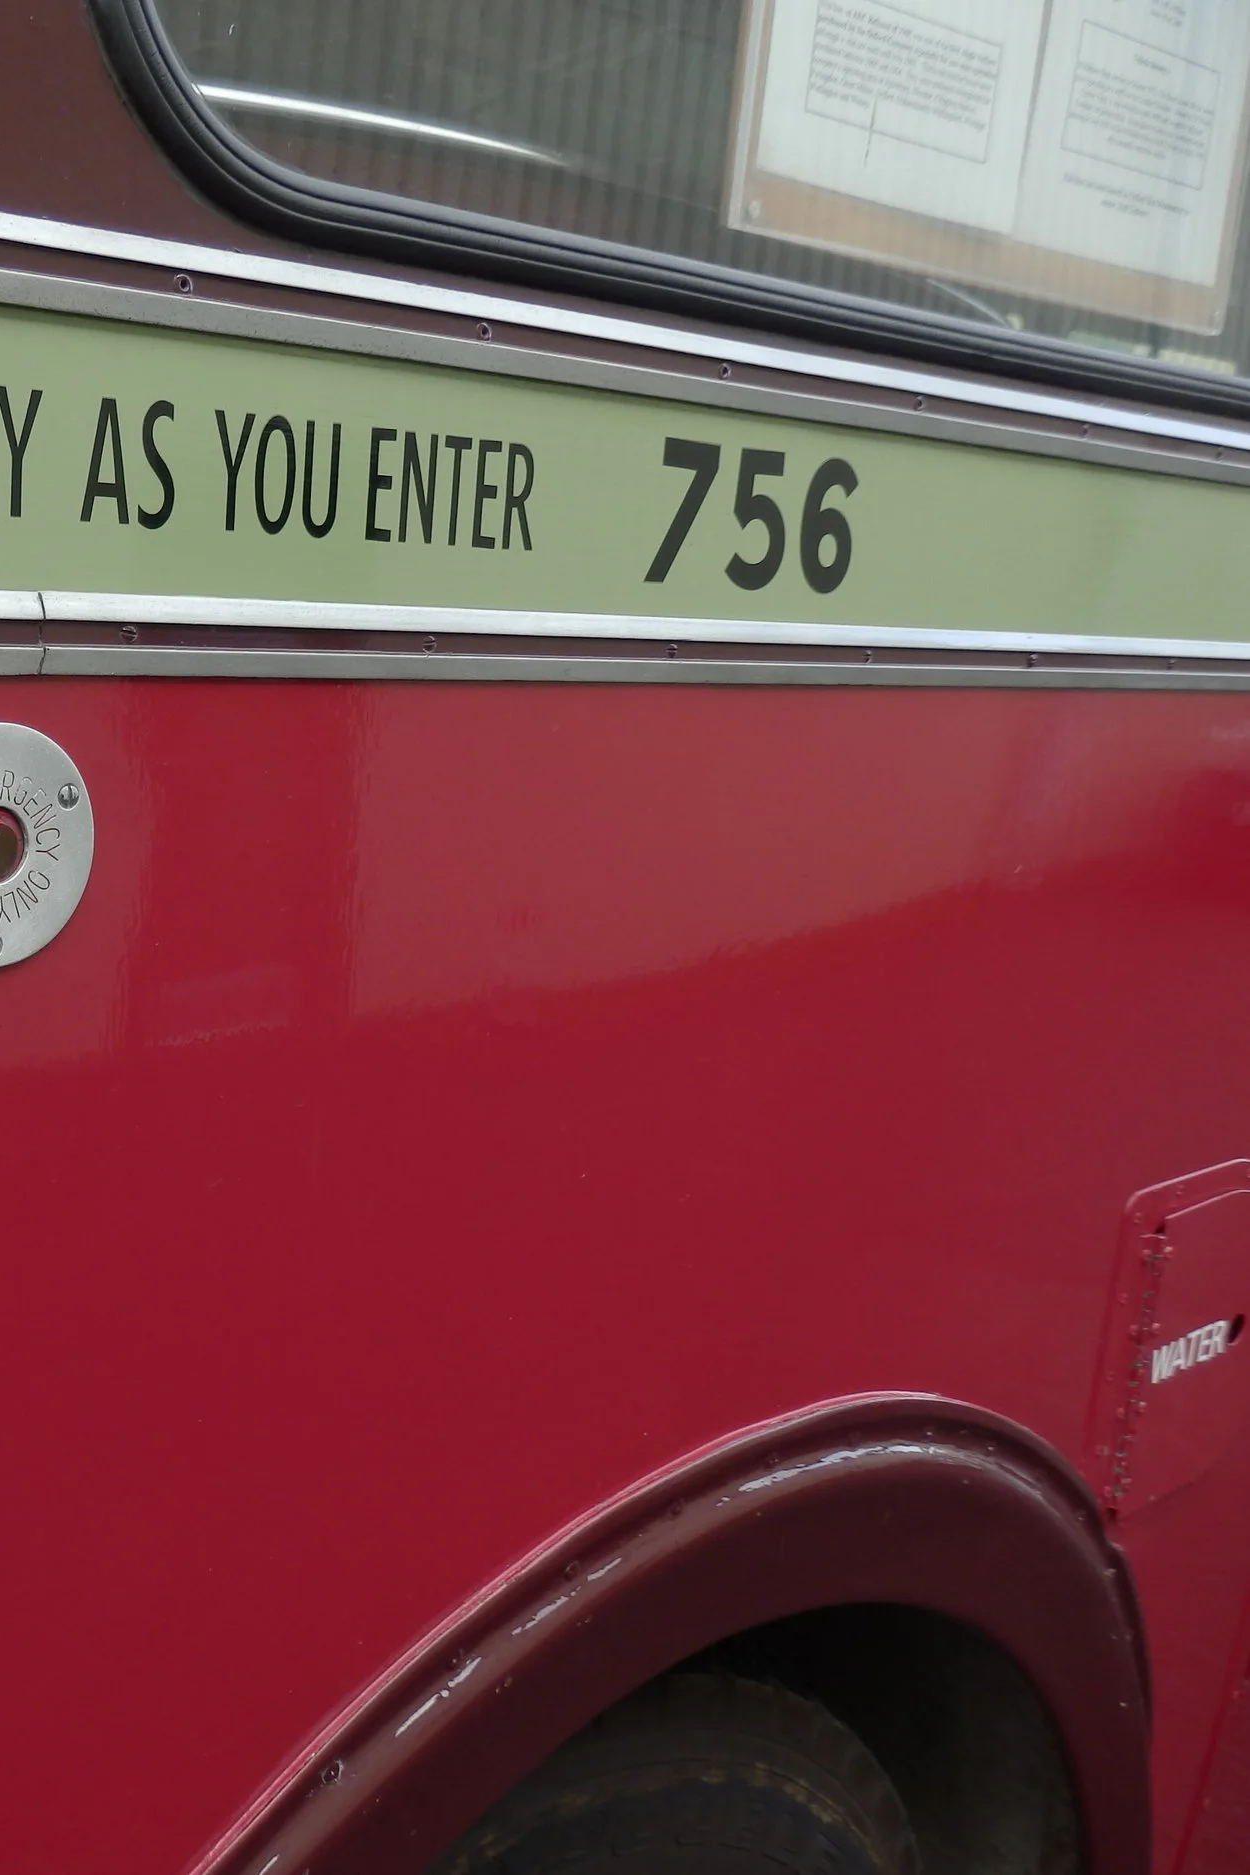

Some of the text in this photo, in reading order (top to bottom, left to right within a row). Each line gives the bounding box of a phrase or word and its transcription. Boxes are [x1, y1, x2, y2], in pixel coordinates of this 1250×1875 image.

[79, 397, 175, 530] AS
[214, 409, 342, 539] YOU
[364, 427, 535, 551] ENTER
[643, 436, 859, 594] 756
[1151, 1319, 1229, 1384] WATER
